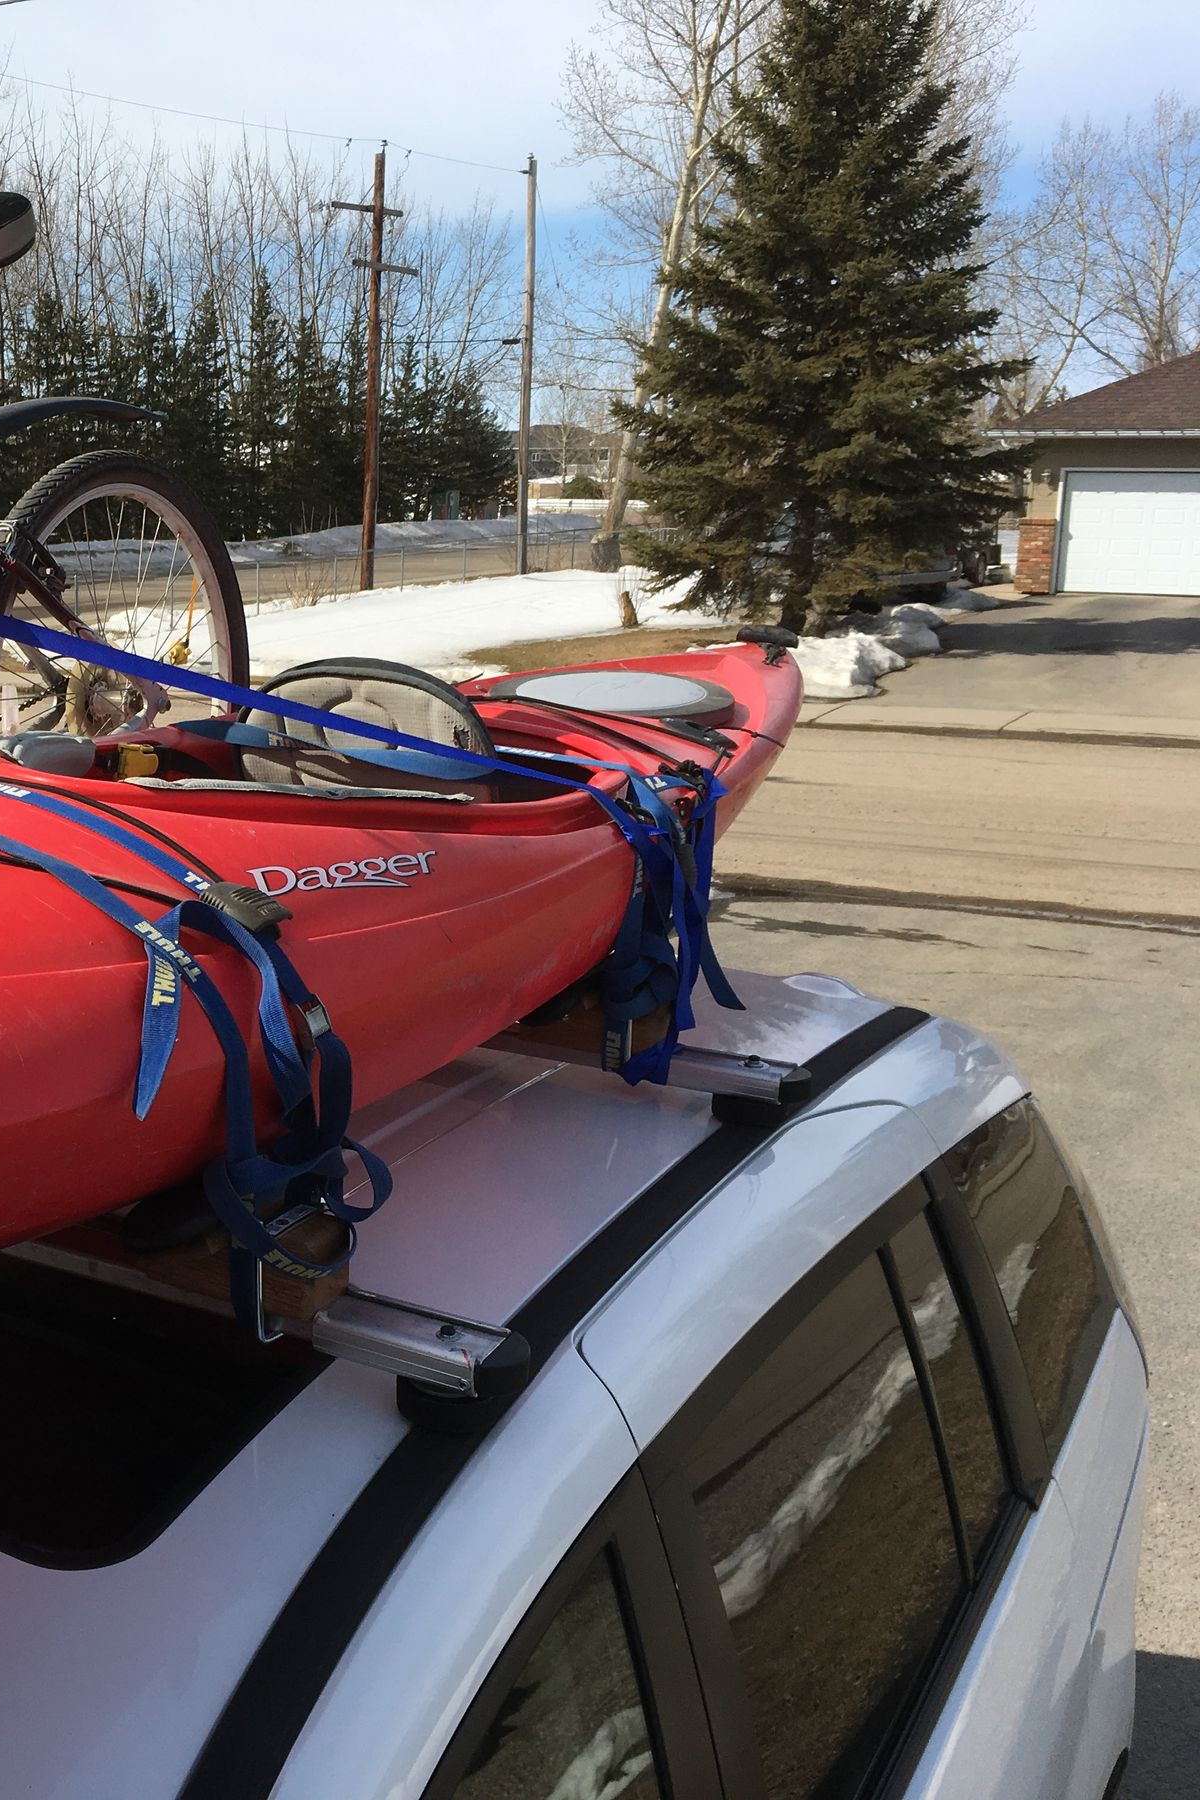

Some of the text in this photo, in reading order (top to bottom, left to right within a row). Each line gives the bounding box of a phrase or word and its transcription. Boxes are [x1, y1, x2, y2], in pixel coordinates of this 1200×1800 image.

[246, 850, 436, 897] Dagger
[134, 920, 201, 983] THULE
[151, 954, 176, 1007] THUL
[606, 1030, 621, 1070] HULE
